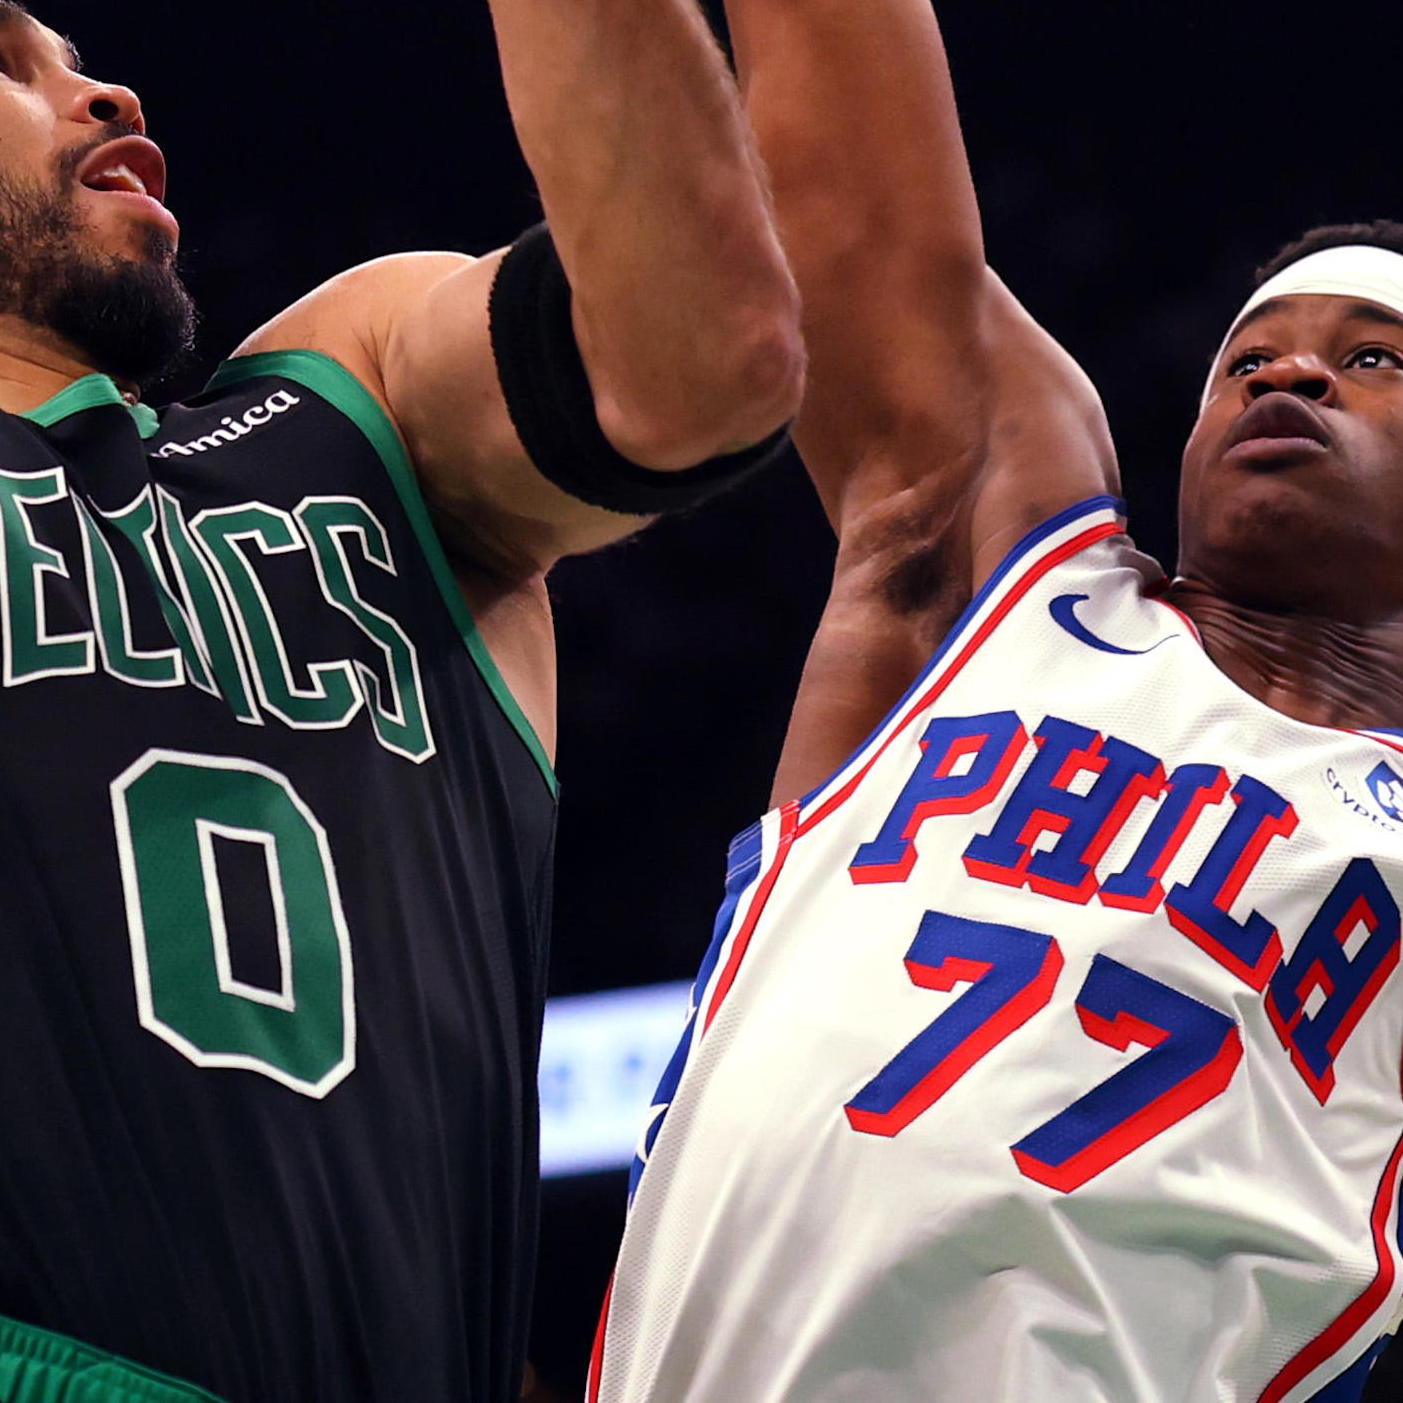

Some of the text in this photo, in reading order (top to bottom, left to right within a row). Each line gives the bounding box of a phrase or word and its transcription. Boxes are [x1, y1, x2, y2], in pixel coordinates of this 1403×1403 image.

[149, 388, 301, 459] Amica
[109, 747, 357, 1099] 0
[843, 909, 1245, 1195] 77
[847, 709, 1402, 1107] PHILA
